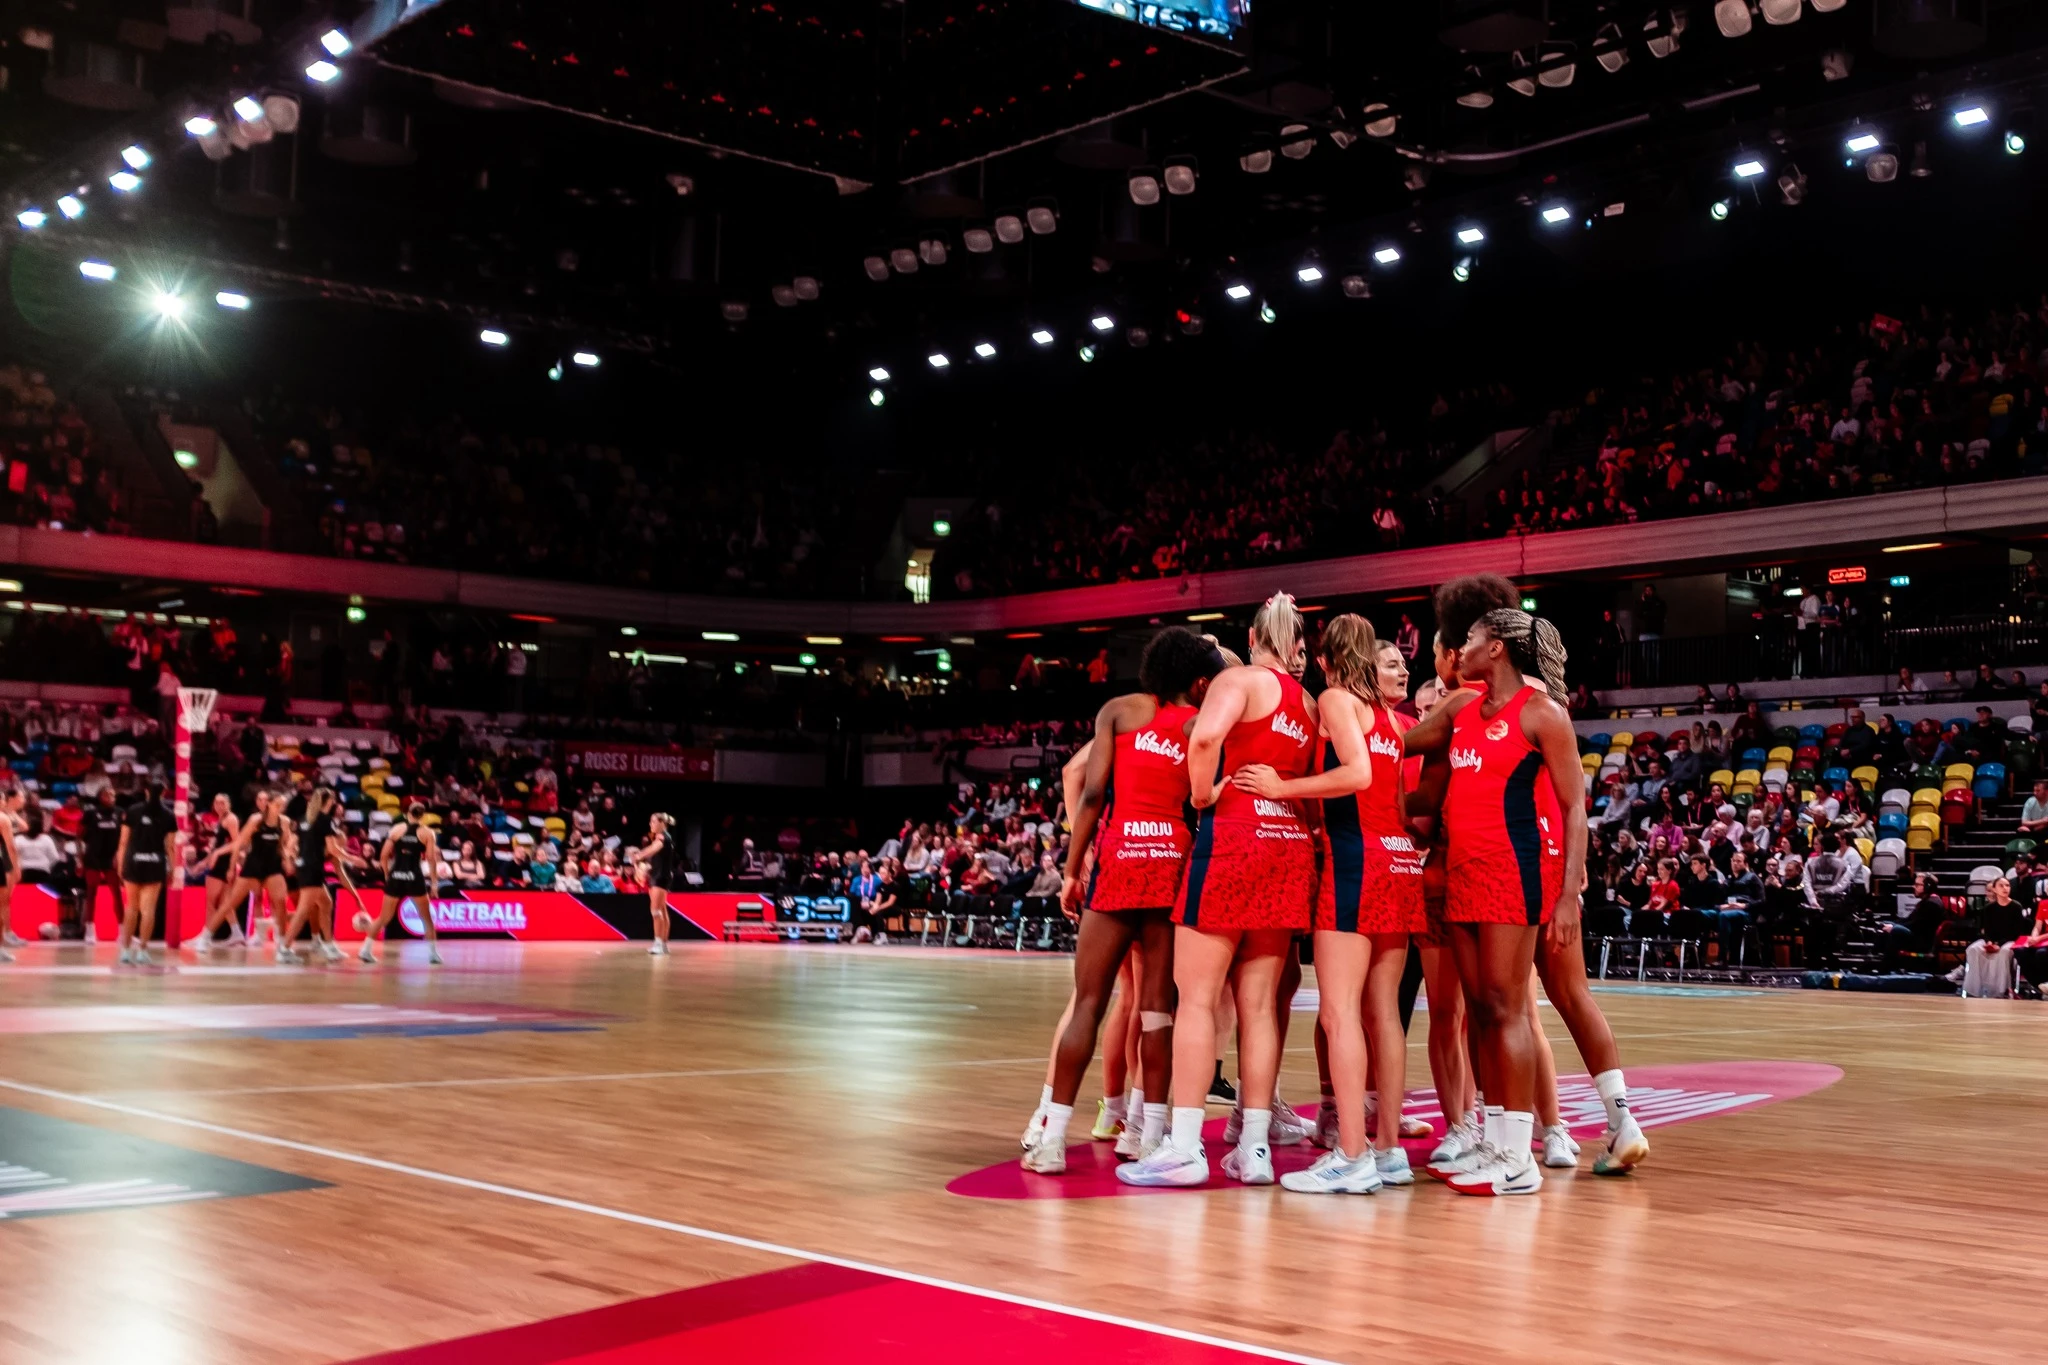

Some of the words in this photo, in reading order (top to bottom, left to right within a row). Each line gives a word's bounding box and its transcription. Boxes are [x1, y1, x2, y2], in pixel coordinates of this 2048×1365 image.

[1134, 730, 1186, 766] Vitality
[584, 751, 628, 772] ROSES
[633, 754, 685, 774] LOUNGE
[1123, 821, 1173, 837] FADOJU
[1255, 829, 1282, 839] Online
[1282, 830, 1309, 840] Doctor
[1116, 849, 1147, 860] Online
[1149, 848, 1183, 859] Doctor
[437, 901, 527, 920] NETBALL
